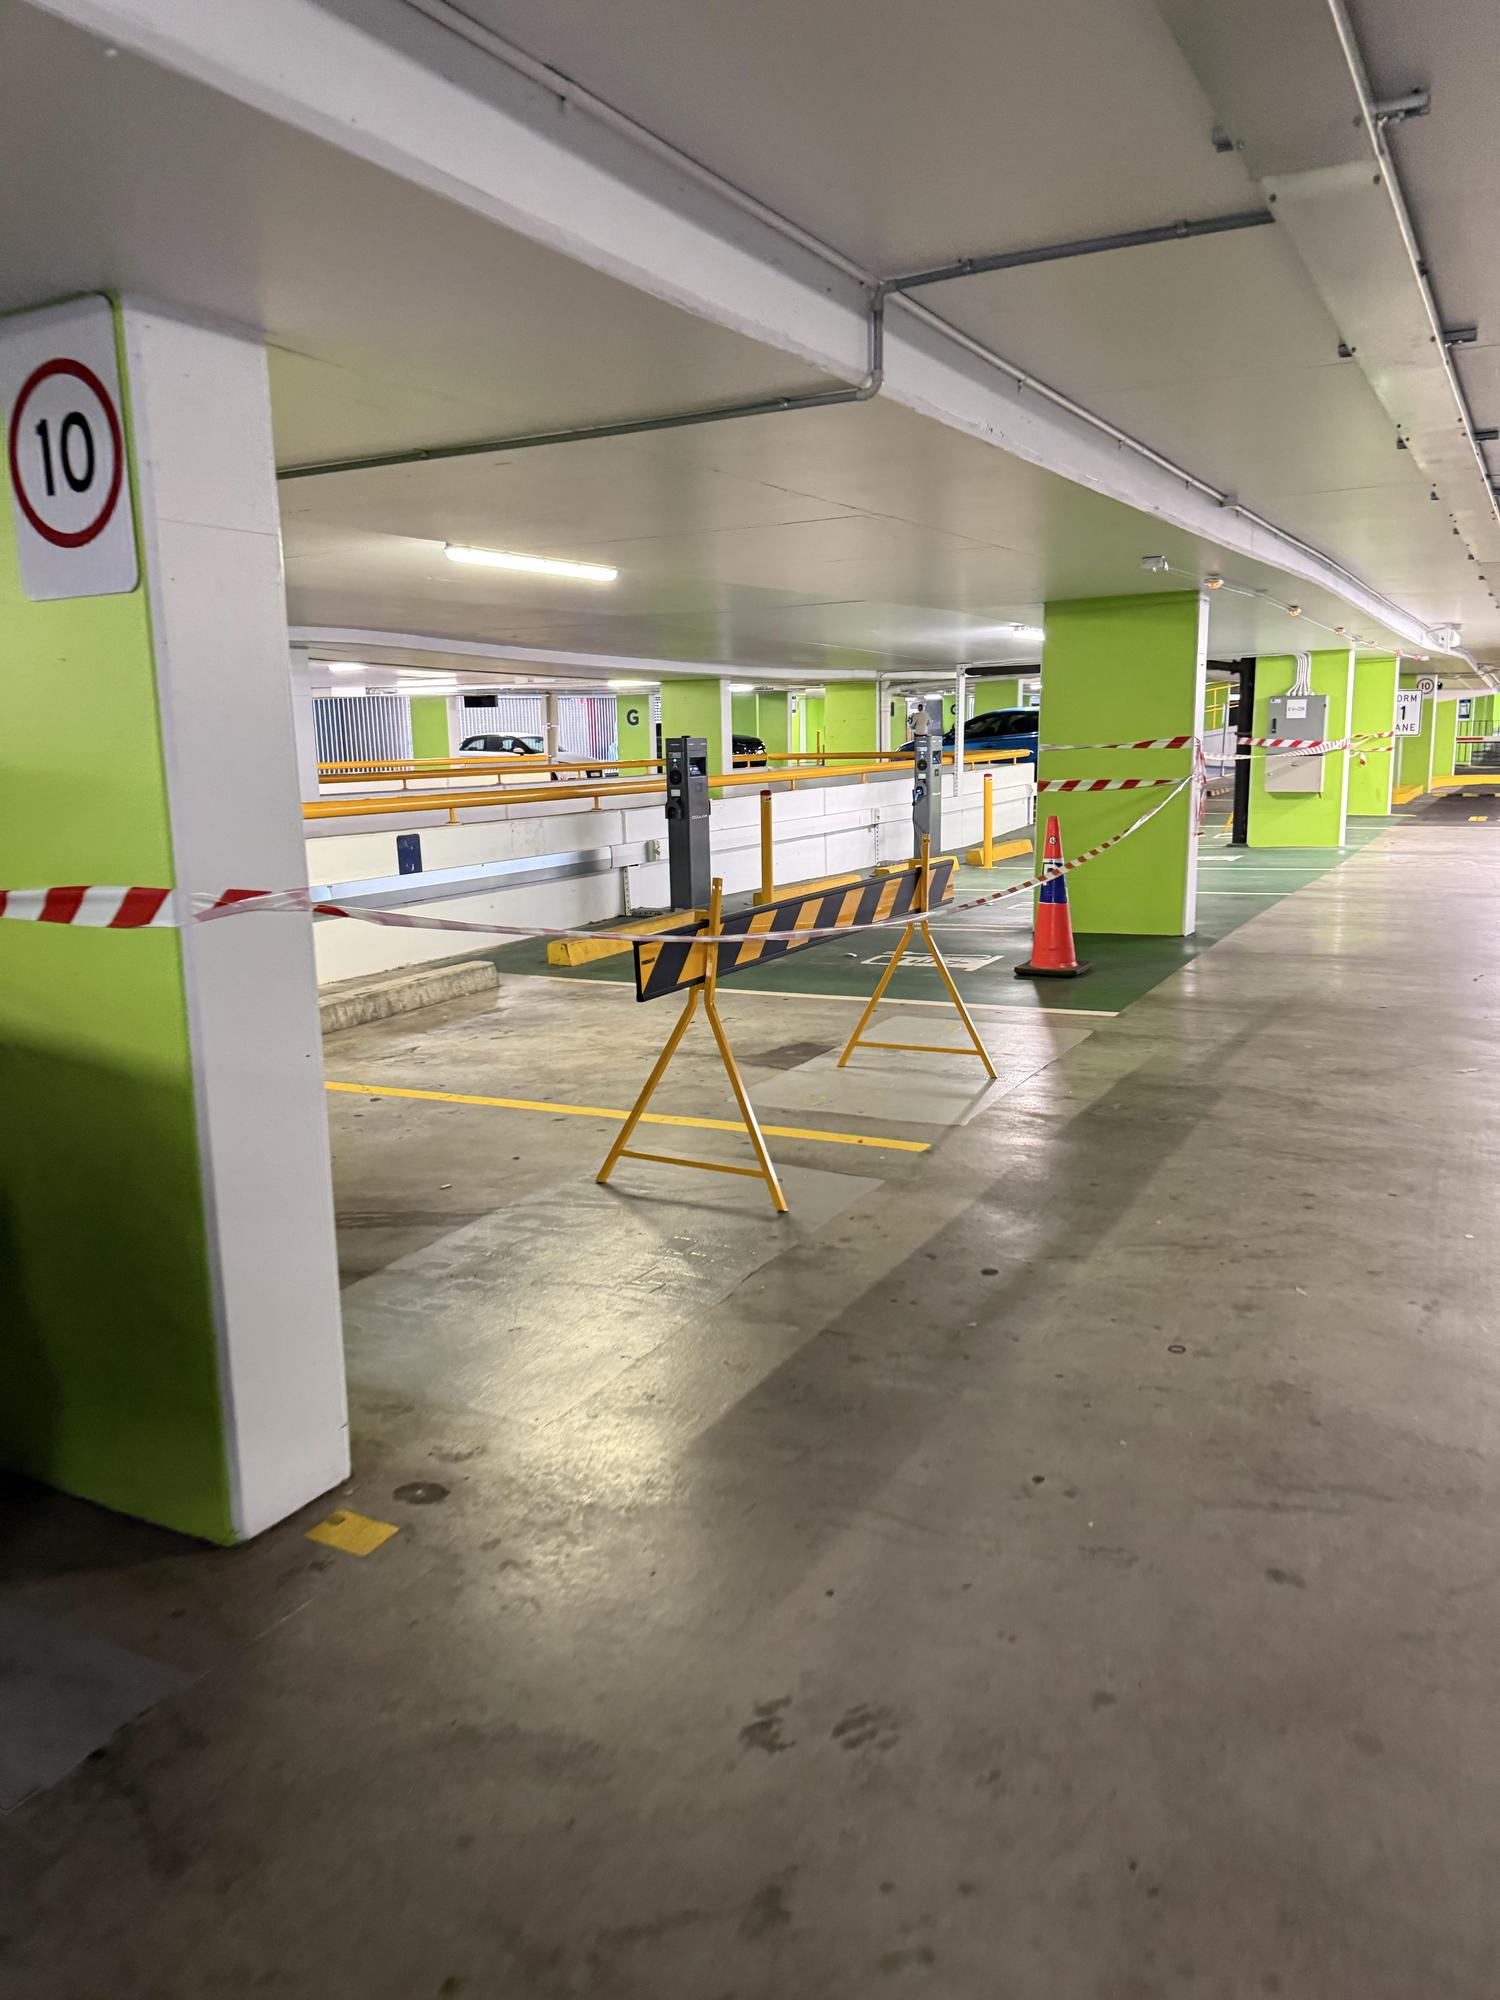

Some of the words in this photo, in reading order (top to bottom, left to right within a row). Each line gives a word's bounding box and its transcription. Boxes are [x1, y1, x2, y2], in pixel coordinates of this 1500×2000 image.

[35, 411, 95, 496] 10
[1421, 682, 1431, 690] 10
[1397, 694, 1417, 702] ORM
[626, 709, 640, 726] G
[1400, 705, 1406, 720] 1
[1395, 723, 1416, 732] ANE
